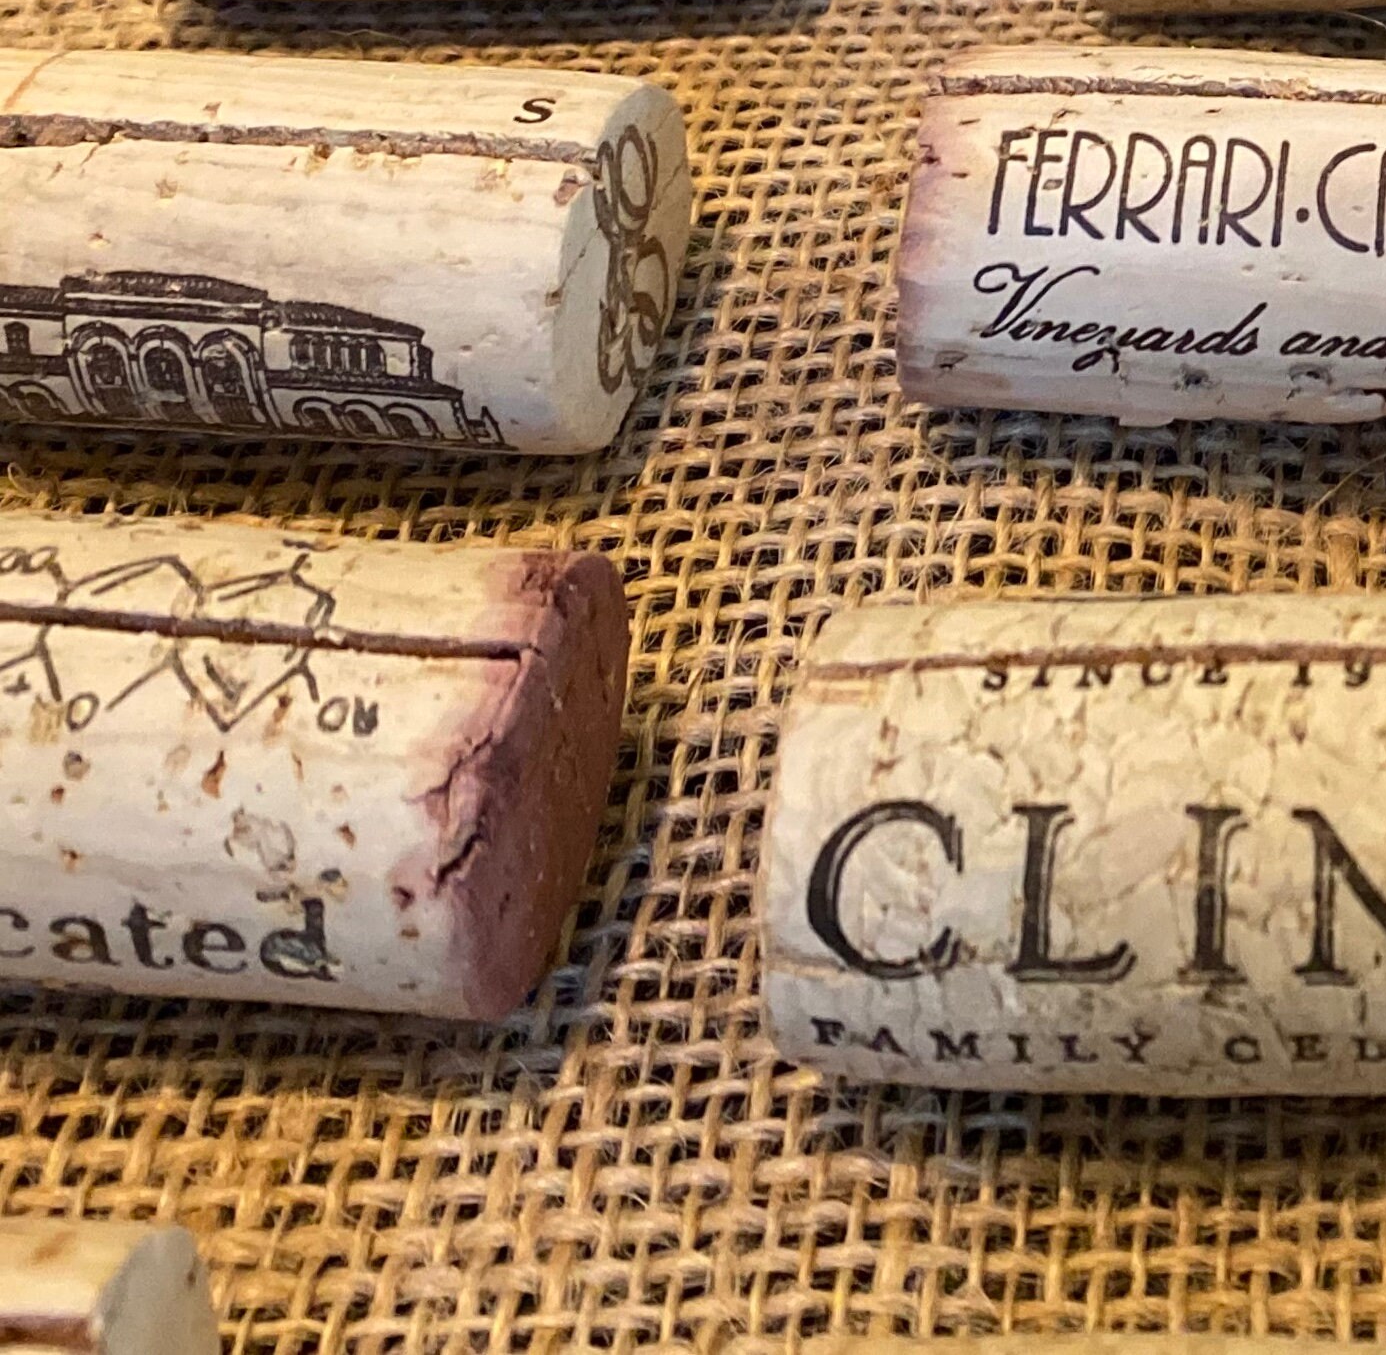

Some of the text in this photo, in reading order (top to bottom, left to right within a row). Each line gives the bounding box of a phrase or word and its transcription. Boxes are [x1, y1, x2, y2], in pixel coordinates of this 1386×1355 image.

[973, 263, 1268, 375] Vineyards
[982, 651, 1229, 691] SINCE
[809, 1015, 1158, 1065] FAMILY
